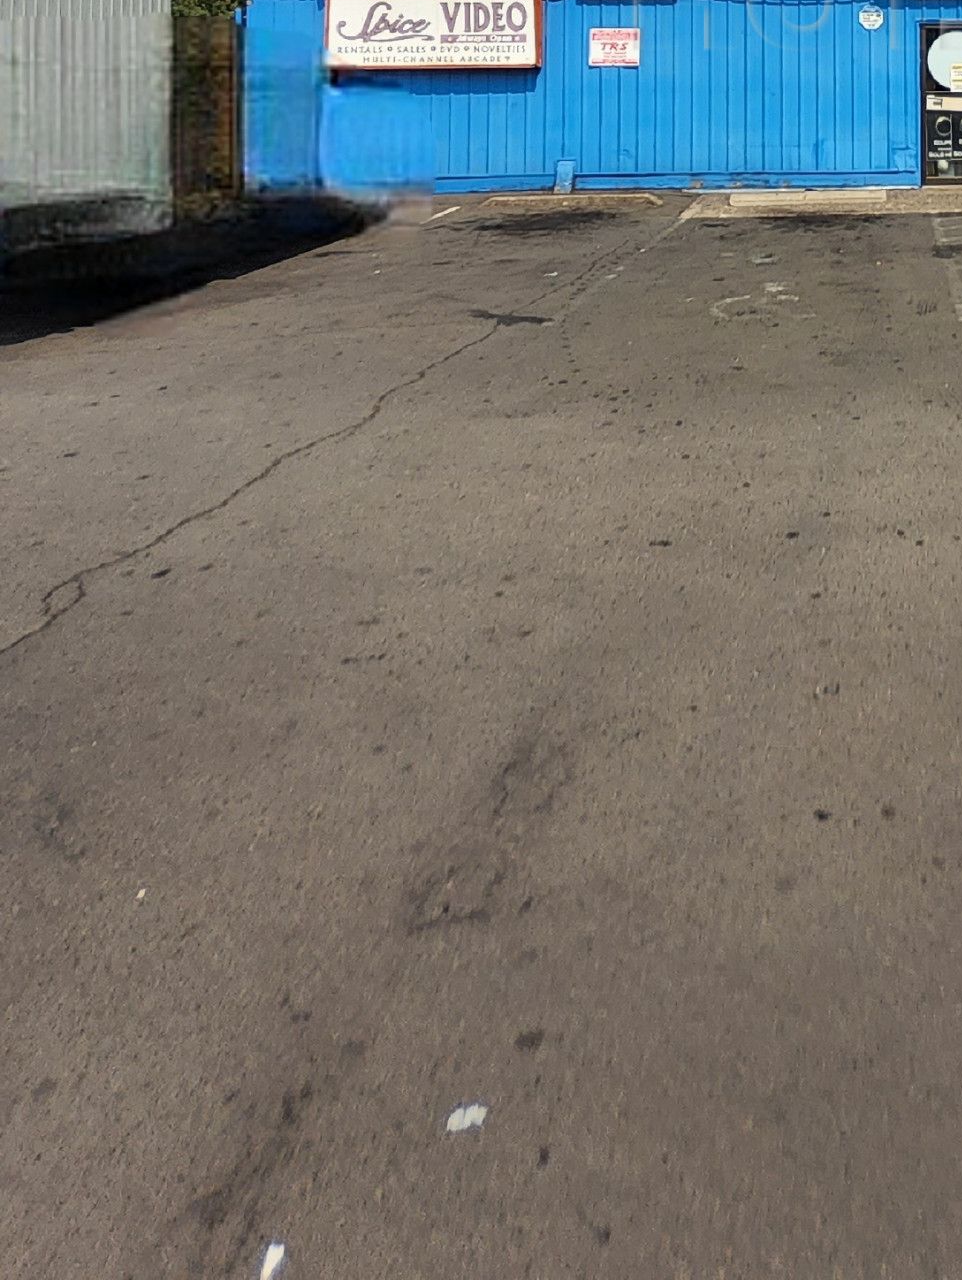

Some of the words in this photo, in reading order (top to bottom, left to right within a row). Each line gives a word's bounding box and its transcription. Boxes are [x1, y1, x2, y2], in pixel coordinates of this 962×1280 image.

[440, 1, 527, 32] VIDEO
[337, 46, 382, 54] RENTALS
[397, 46, 426, 54] SALES
[440, 45, 460, 53] DVD
[473, 45, 526, 54] NOVELTIES
